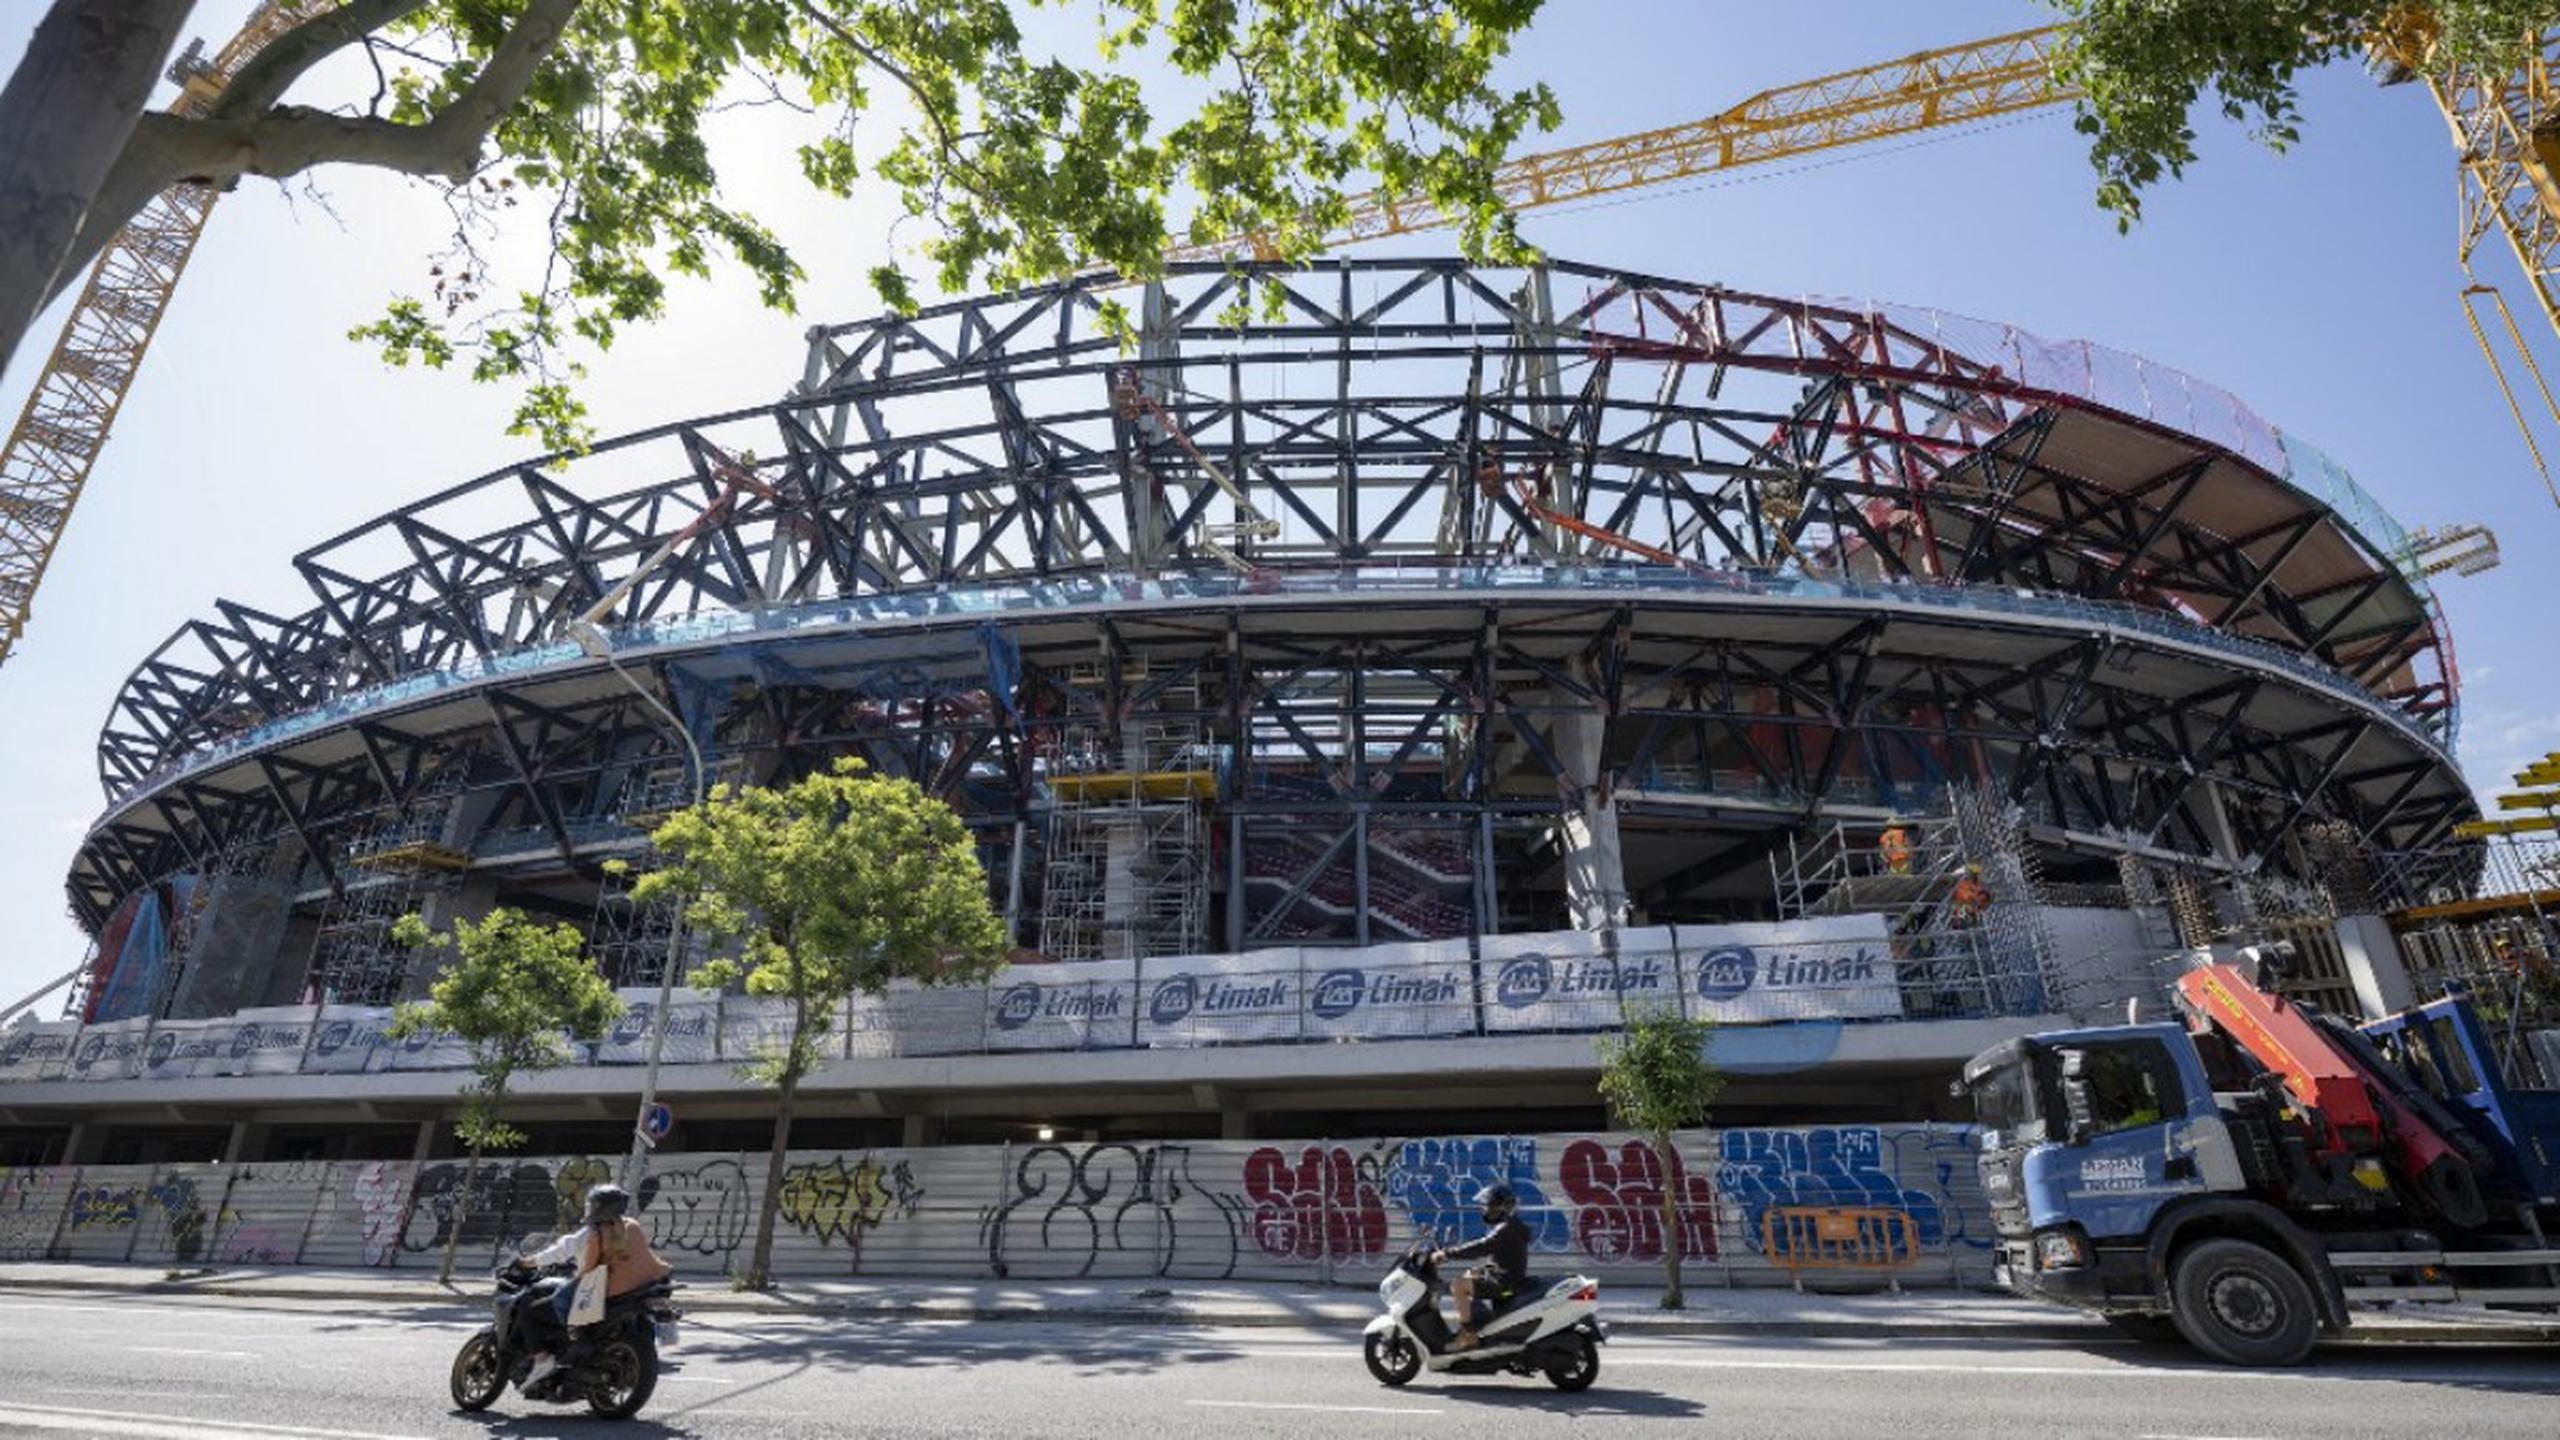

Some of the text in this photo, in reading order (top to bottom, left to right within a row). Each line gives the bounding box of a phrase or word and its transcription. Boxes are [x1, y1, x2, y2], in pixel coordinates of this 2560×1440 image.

[1559, 959, 1663, 993] Limak
[1766, 949, 1876, 986] Limak
[1045, 986, 1122, 1017] Limak
[1203, 979, 1288, 1011] Limak
[1369, 972, 1459, 1004] Limak
